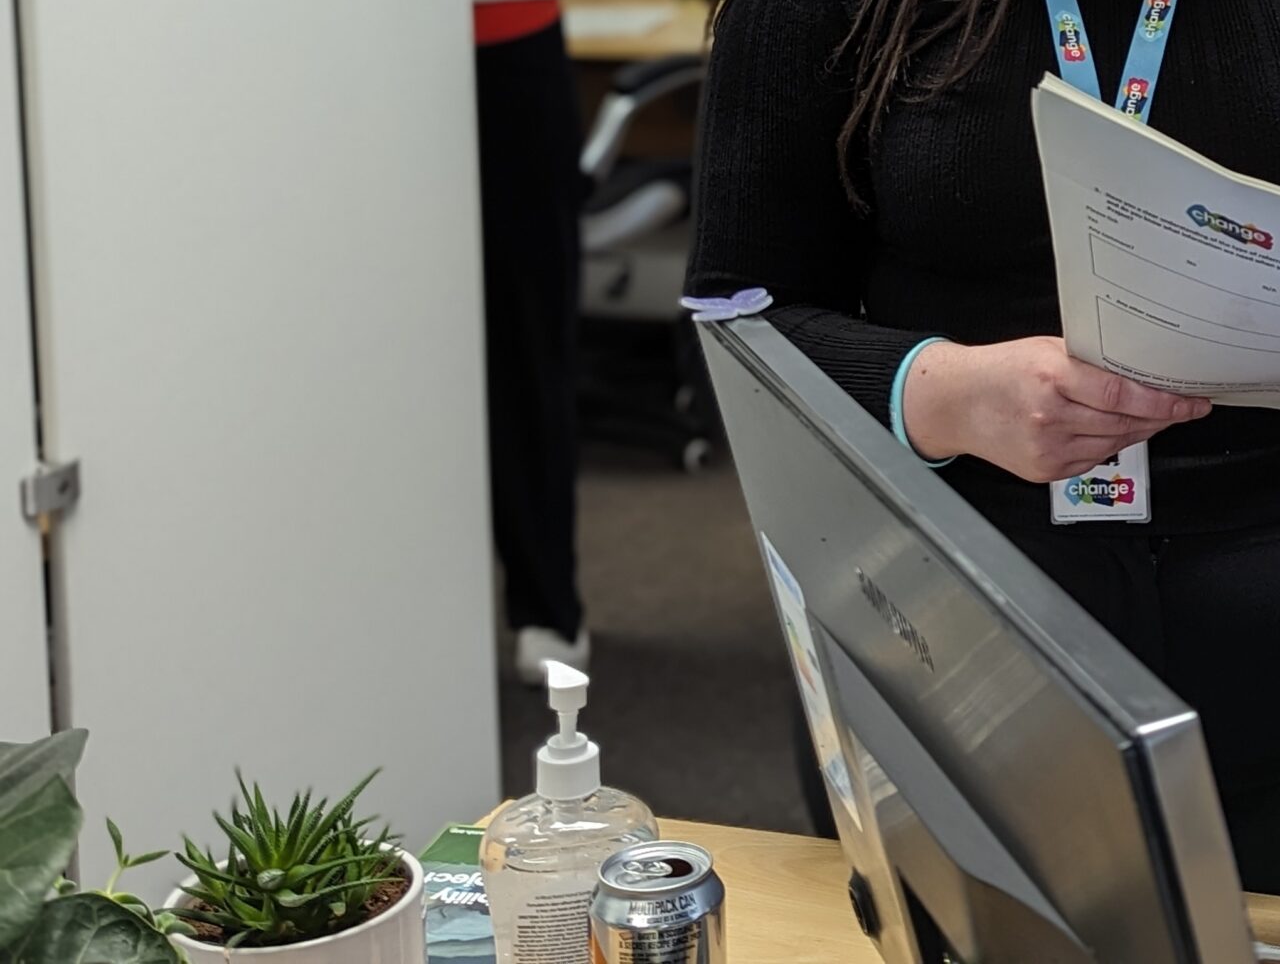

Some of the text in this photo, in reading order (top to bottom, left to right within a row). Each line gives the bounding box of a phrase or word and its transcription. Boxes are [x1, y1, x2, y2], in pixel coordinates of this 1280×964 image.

[1061, 13, 1081, 58] change
[1125, 82, 1142, 116] ange
[1190, 207, 1267, 243] change
[1068, 479, 1129, 499] change
[628, 891, 698, 916] MULTIPACK CAN
